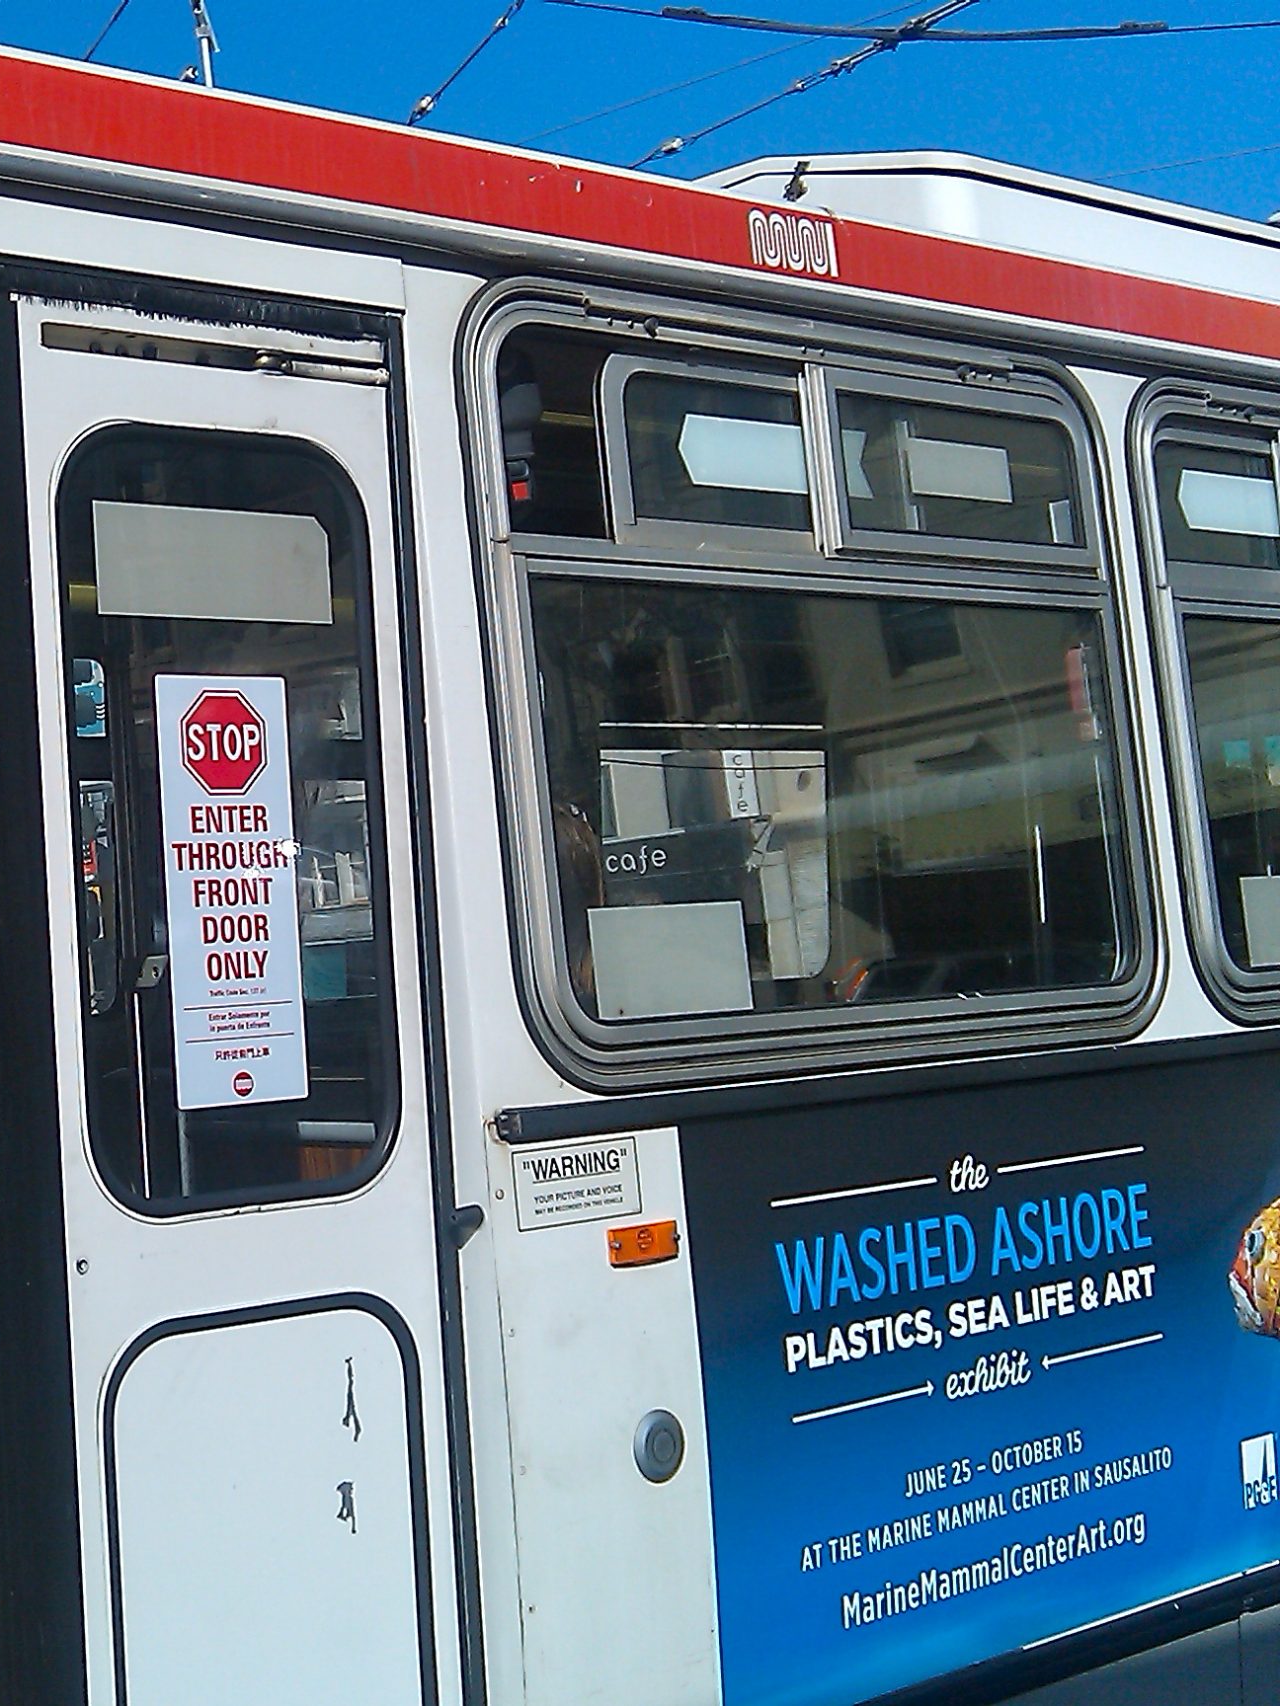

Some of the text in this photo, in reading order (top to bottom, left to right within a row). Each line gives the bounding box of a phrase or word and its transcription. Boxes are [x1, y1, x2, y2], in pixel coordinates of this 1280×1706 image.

[188, 723, 260, 762] STOP
[191, 805, 268, 833] ENTER
[605, 845, 667, 875] cafe
[193, 878, 272, 907] FRONT
[203, 914, 269, 944] DOOR
[207, 950, 268, 981] ONLY
[523, 1148, 627, 1181] "WARNING"
[949, 1156, 989, 1192] the
[534, 1184, 623, 1204] YOUR PICTURE AND VOICE
[775, 1183, 1153, 1315] WASHED ASHORE
[785, 1265, 1155, 1373] PLASTICS, SEA LIFE & ART
[945, 1352, 1032, 1400] exhibit
[905, 1467, 947, 1499] JUNE
[951, 1458, 971, 1485] 25
[991, 1437, 1061, 1474] OCTOBER
[1066, 1430, 1083, 1455] 15
[1245, 1475, 1278, 1508] PG&E
[801, 1446, 1173, 1573] AT THE MARINE MAMMAL CENTER IN SAUSALITO
[843, 1511, 1147, 1630] MarineMammalCenterArt.org
